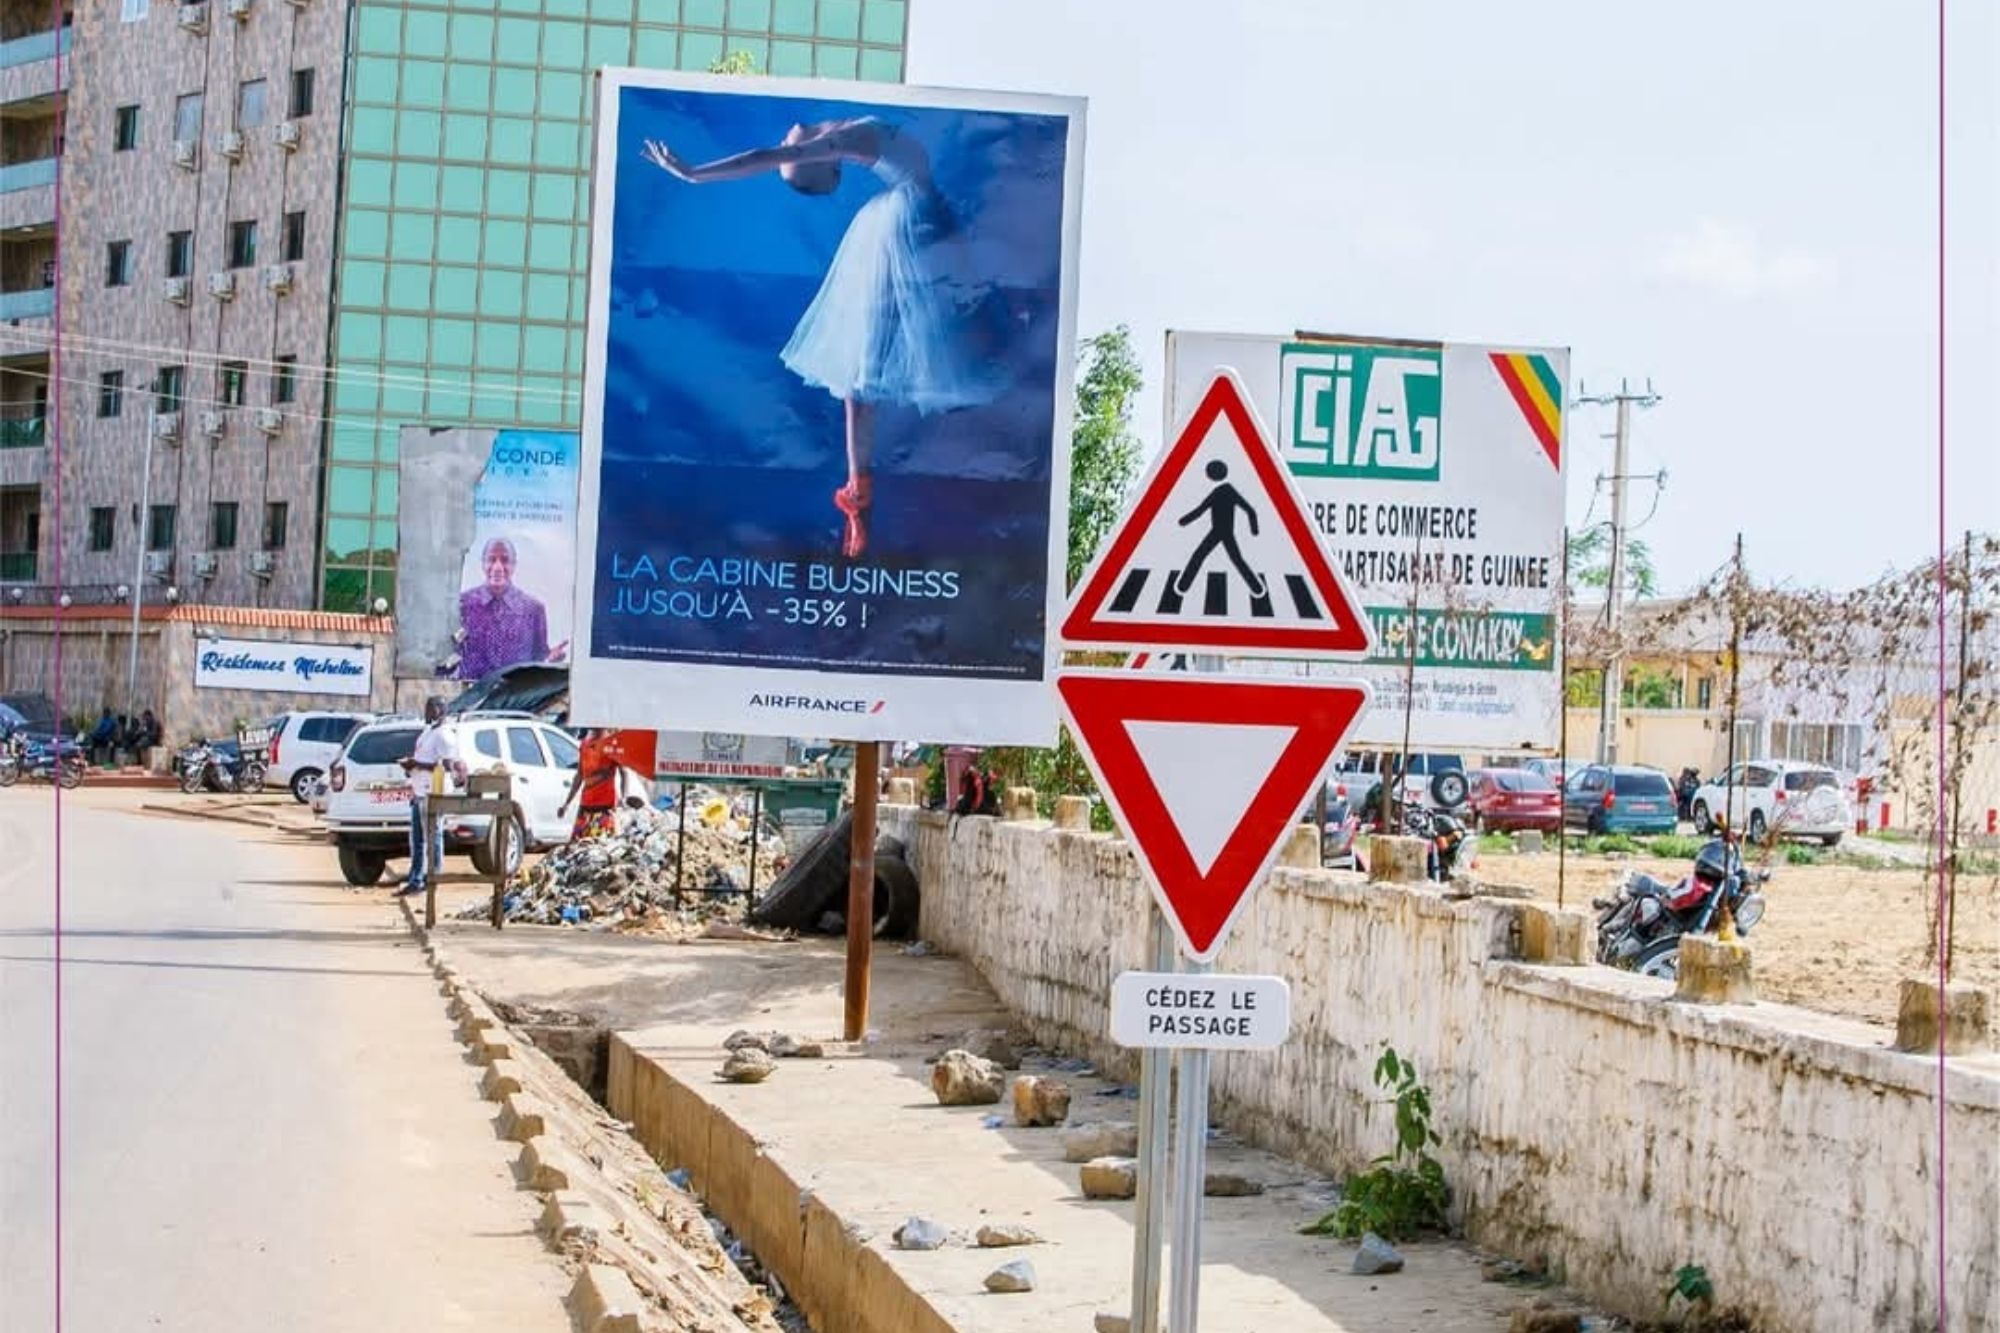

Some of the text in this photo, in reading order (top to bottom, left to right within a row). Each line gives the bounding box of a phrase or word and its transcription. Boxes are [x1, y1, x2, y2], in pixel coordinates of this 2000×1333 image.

[1309, 503, 1478, 540] RE DE COMMERCE
[612, 554, 961, 599] LA CABINE BUSINESS
[1333, 550, 1550, 588] 'ARTISANAT DE GUINEE
[610, 588, 753, 621] JUSQU'À
[765, 598, 848, 628] -35%
[1433, 617, 1525, 663] CONAKRY
[294, 656, 364, 681] Micheline
[749, 694, 867, 713] AIRFRANCE
[1146, 985, 1256, 1010] CÉDEZ LE
[1150, 1015, 1251, 1036] PASSAGE
